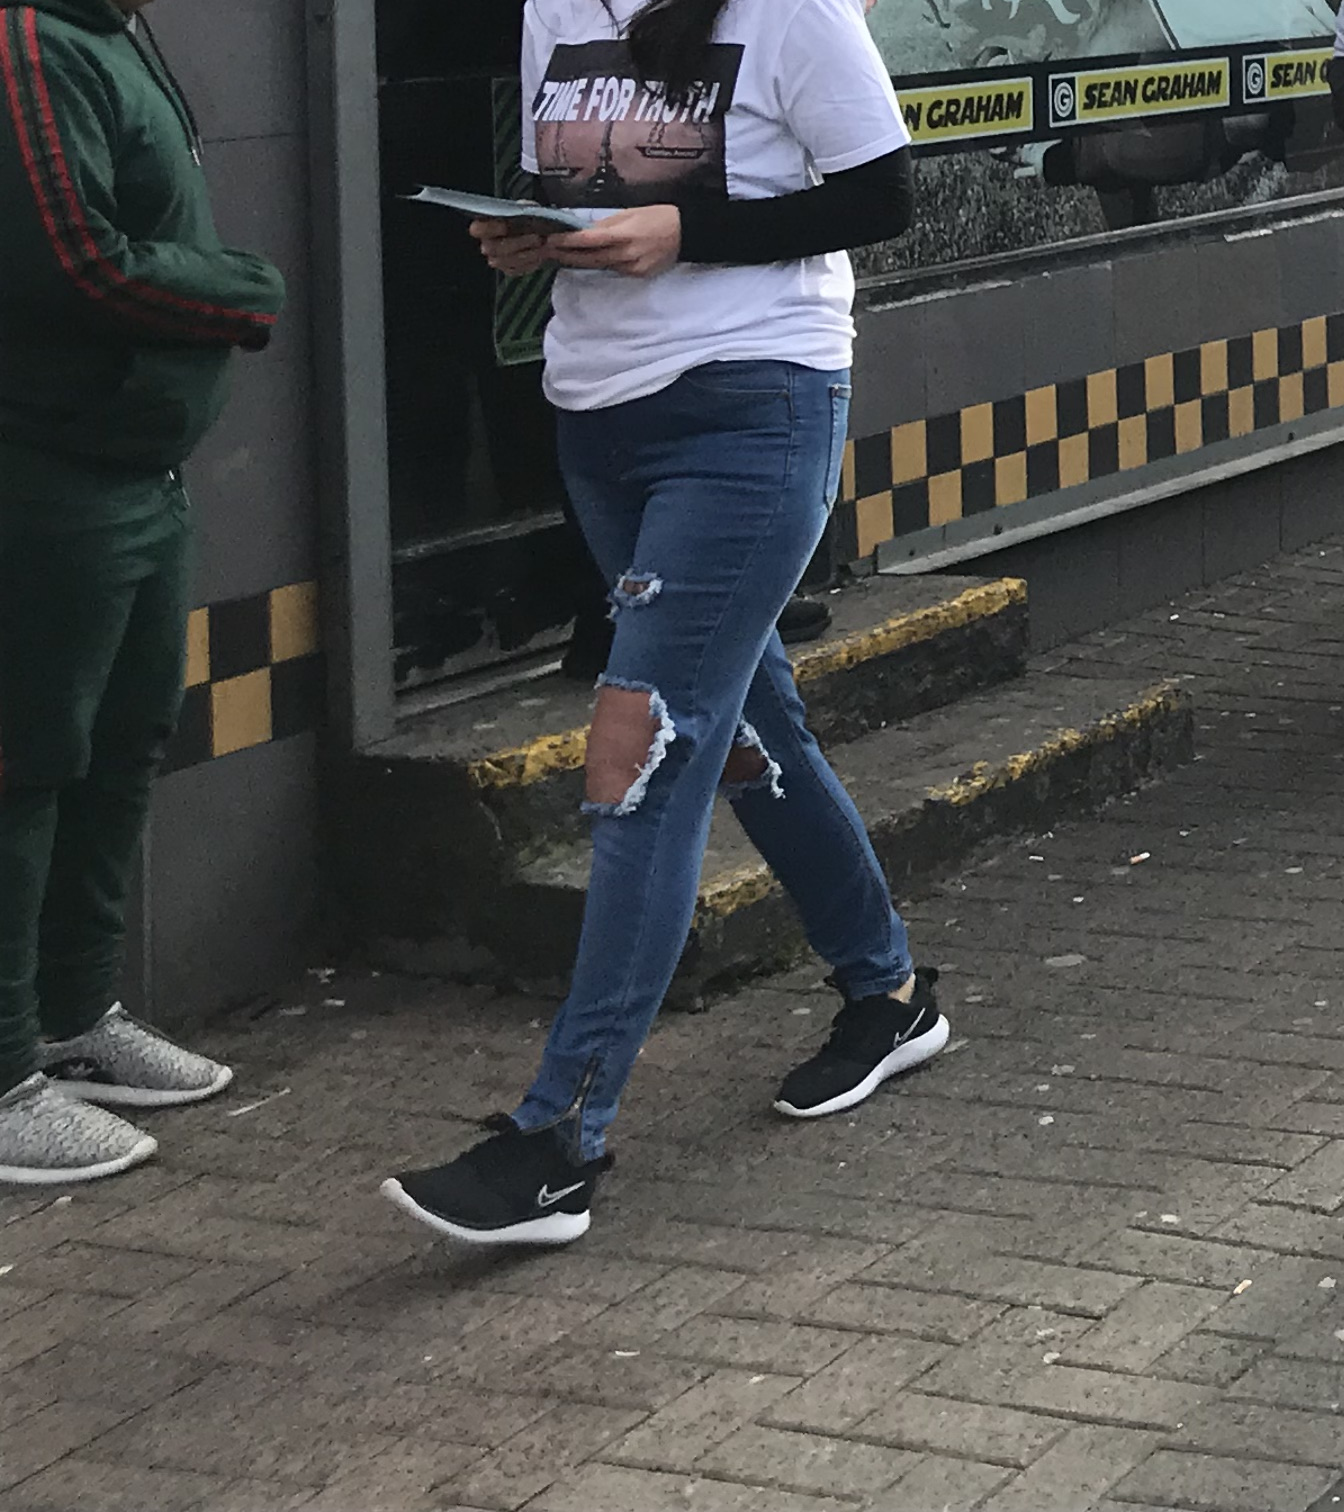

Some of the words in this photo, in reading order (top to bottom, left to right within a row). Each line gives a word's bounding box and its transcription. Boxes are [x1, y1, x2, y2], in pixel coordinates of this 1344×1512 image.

[1082, 78, 1139, 111] SEAN
[1142, 68, 1222, 105] GRAHAM
[1270, 60, 1317, 89] SEAN
[533, 78, 588, 121] TIME
[583, 76, 636, 122] FOR
[926, 90, 1024, 130] GRAHAM
